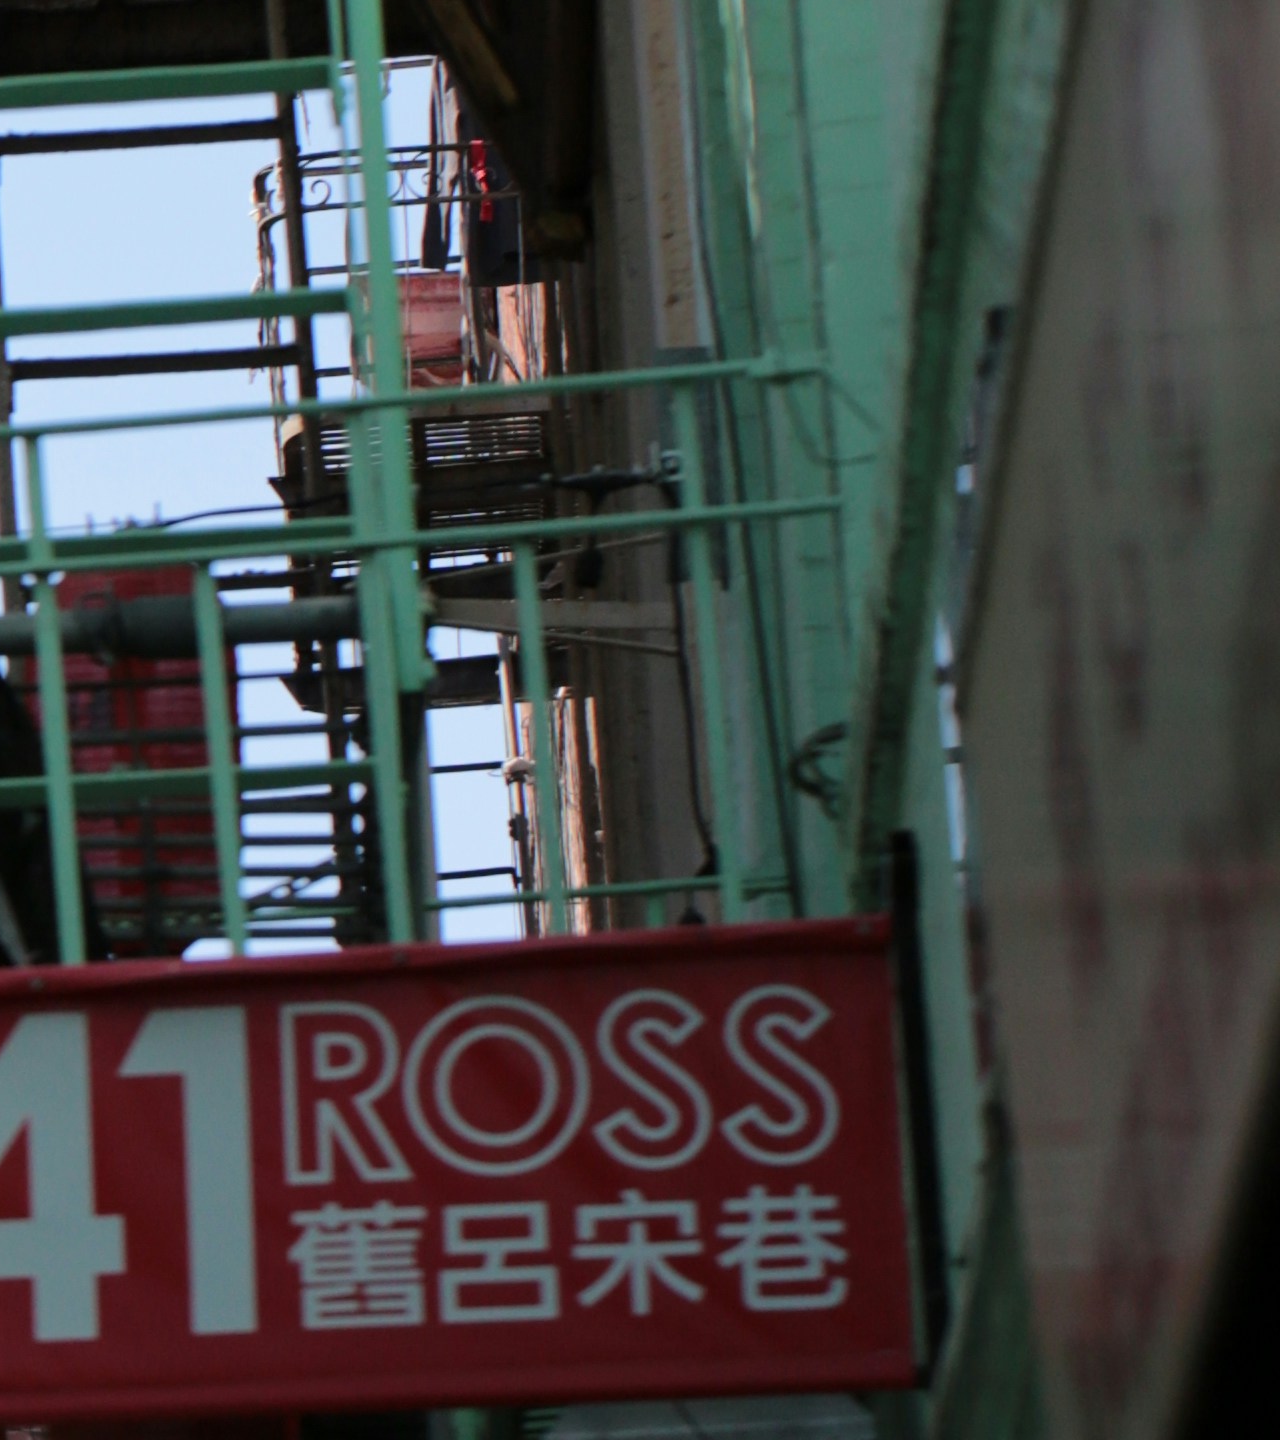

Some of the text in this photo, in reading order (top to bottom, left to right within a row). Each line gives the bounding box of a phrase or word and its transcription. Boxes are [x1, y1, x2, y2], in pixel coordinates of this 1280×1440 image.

[278, 983, 842, 1186] ROSS
[286, 1184, 850, 1331] 舊呂宋巷
